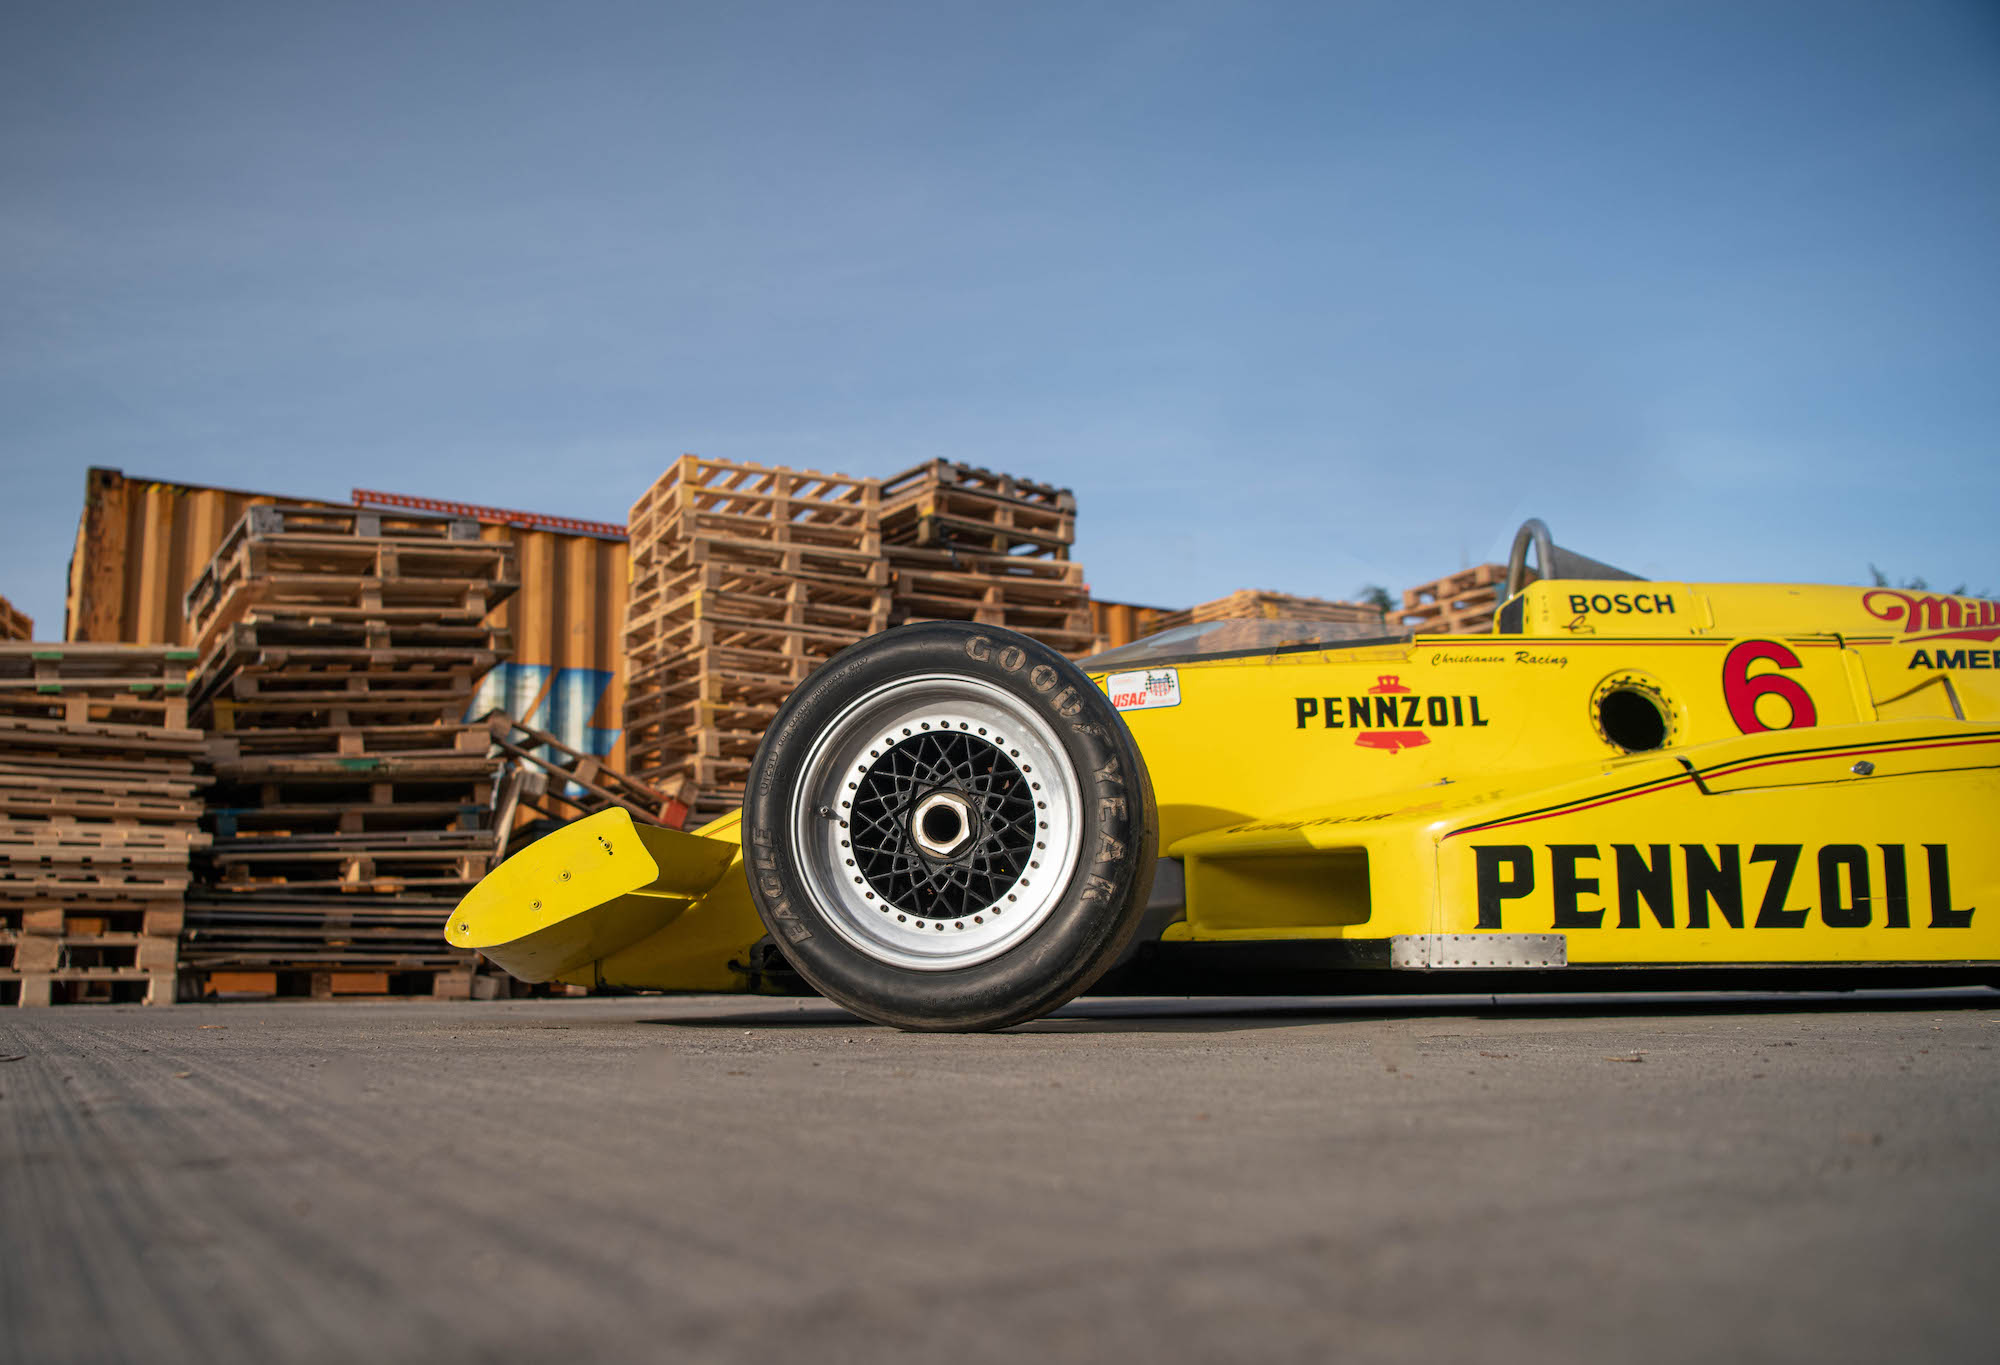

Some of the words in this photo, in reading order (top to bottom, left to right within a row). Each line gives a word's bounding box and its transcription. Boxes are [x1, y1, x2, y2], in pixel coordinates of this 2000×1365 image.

[1568, 594, 1676, 614] BOSCH
[1514, 651, 1568, 668] Racing
[1113, 691, 1147, 708] USAC
[1722, 639, 1818, 735] 6
[1296, 695, 1489, 729] PENNZOIL
[1468, 843, 1976, 930] PENNZOIL
